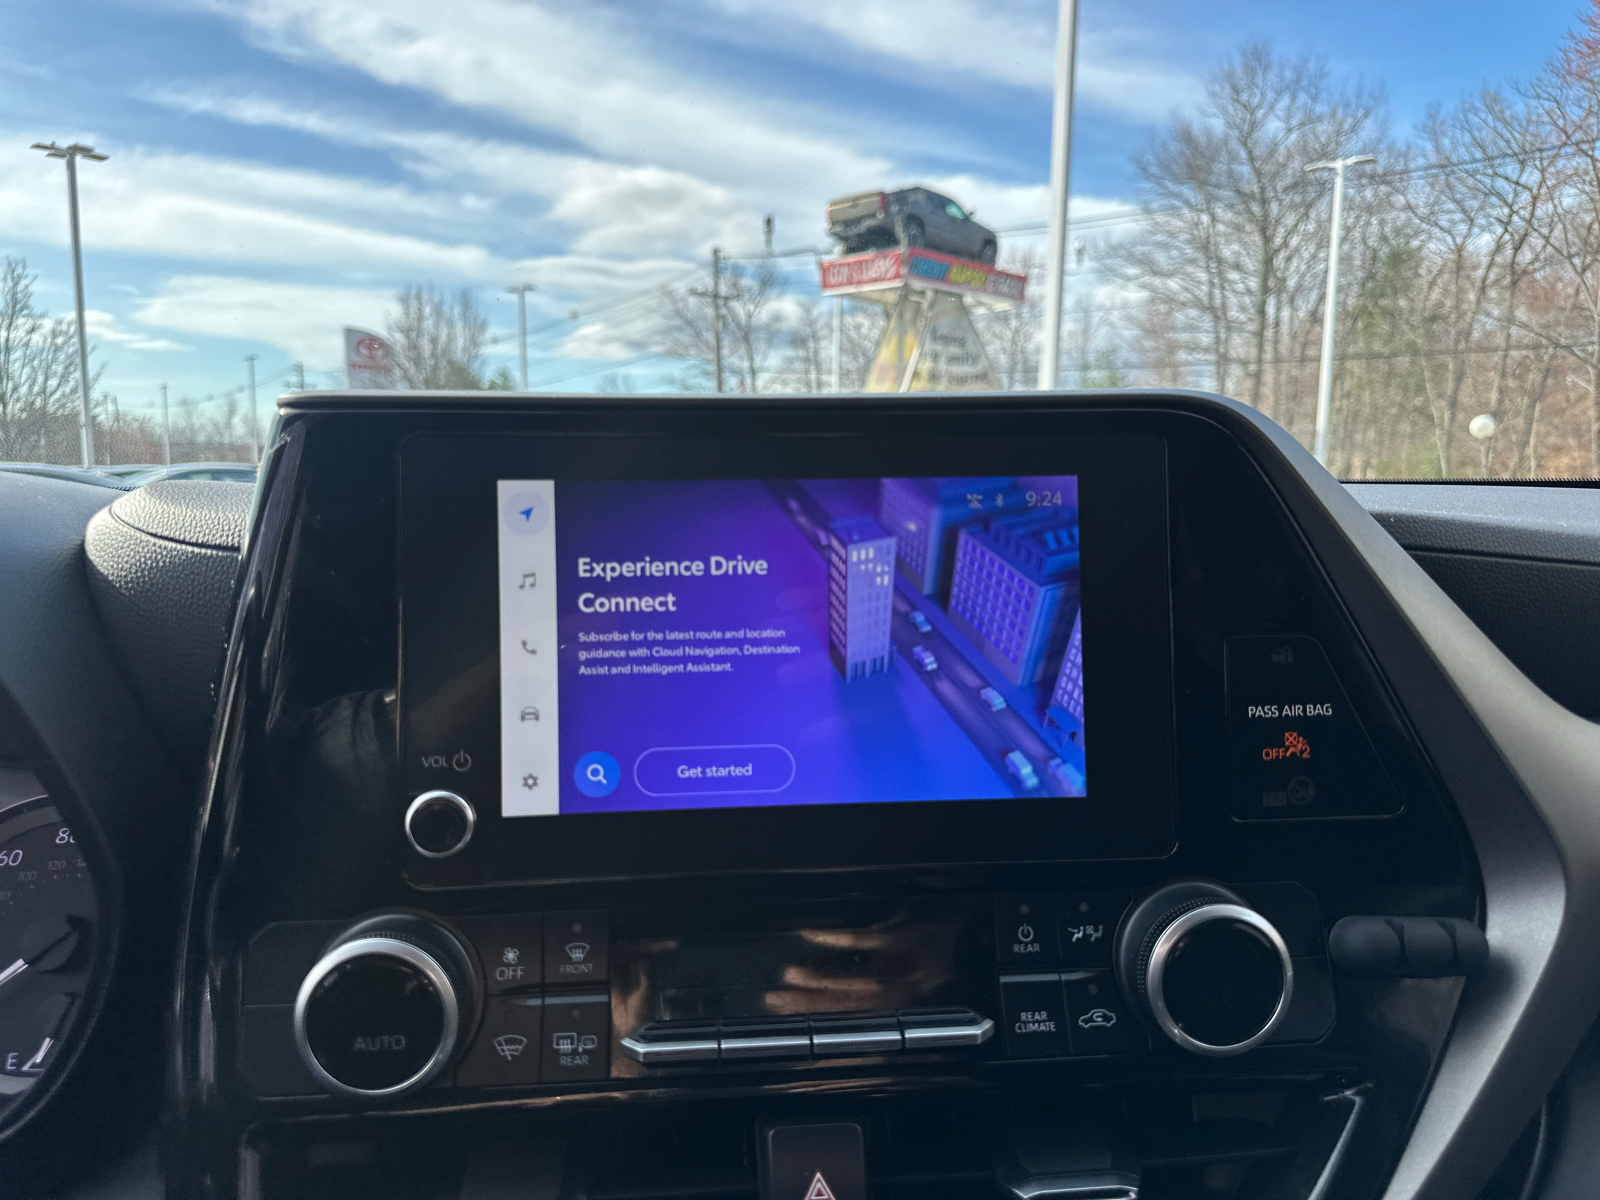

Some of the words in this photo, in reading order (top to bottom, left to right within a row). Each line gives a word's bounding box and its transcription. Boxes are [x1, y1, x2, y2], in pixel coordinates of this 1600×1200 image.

[1026, 491, 1062, 507] 9:24
[578, 556, 705, 581] Experience
[710, 555, 768, 576] Drive
[578, 593, 676, 613] Connect
[579, 632, 629, 642] Subscribe
[631, 631, 645, 641] for
[647, 630, 664, 640] the
[666, 629, 694, 640] latest
[696, 630, 722, 639] route
[724, 629, 744, 639] and
[746, 628, 785, 638] location
[579, 648, 626, 661] guidance
[628, 647, 650, 658] with
[652, 646, 683, 657] Cloud
[685, 646, 742, 658] Navigation,
[744, 644, 800, 655] Destination
[579, 665, 609, 675] Assist
[611, 664, 630, 674] and
[633, 663, 684, 675] Intelligent
[686, 662, 734, 673] Assistant.
[1248, 706, 1279, 718] PASS
[1282, 705, 1303, 717] AIR
[1306, 704, 1333, 716] BAG
[1262, 748, 1286, 760] OFF
[1302, 746, 1311, 758] 2
[421, 756, 449, 767] VOL
[677, 765, 703, 778] Get
[705, 763, 753, 777] started
[1013, 943, 1041, 953] REAR
[496, 967, 525, 981] OFF
[560, 963, 593, 974] FRONT
[1020, 1011, 1048, 1022] REAR
[1015, 1022, 1057, 1033] CLIMATE
[353, 1035, 405, 1051] AUTO
[6, 1052, 19, 1070] E
[560, 1055, 589, 1066] REAR
